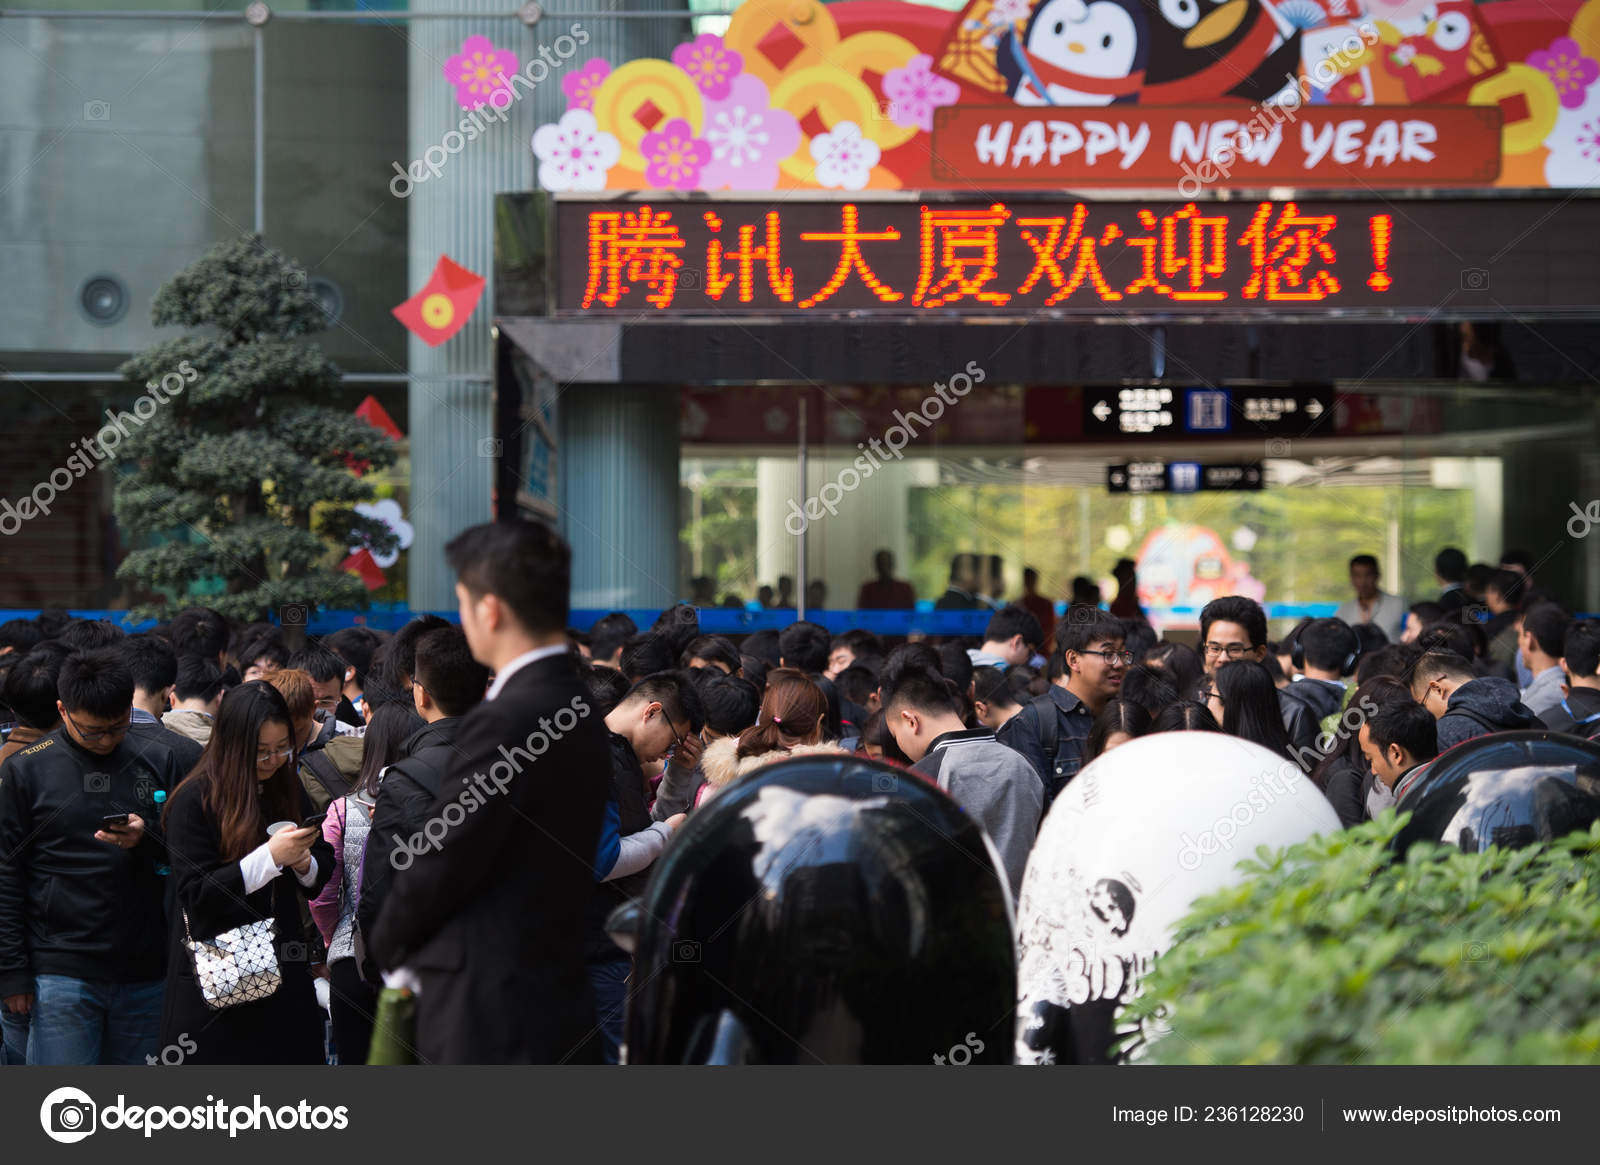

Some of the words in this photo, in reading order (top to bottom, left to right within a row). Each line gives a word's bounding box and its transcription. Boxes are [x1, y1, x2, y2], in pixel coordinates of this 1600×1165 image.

[975, 120, 1151, 169] HAPPY
[1170, 121, 1284, 166] NEW
[1303, 120, 1438, 169] YEAR
